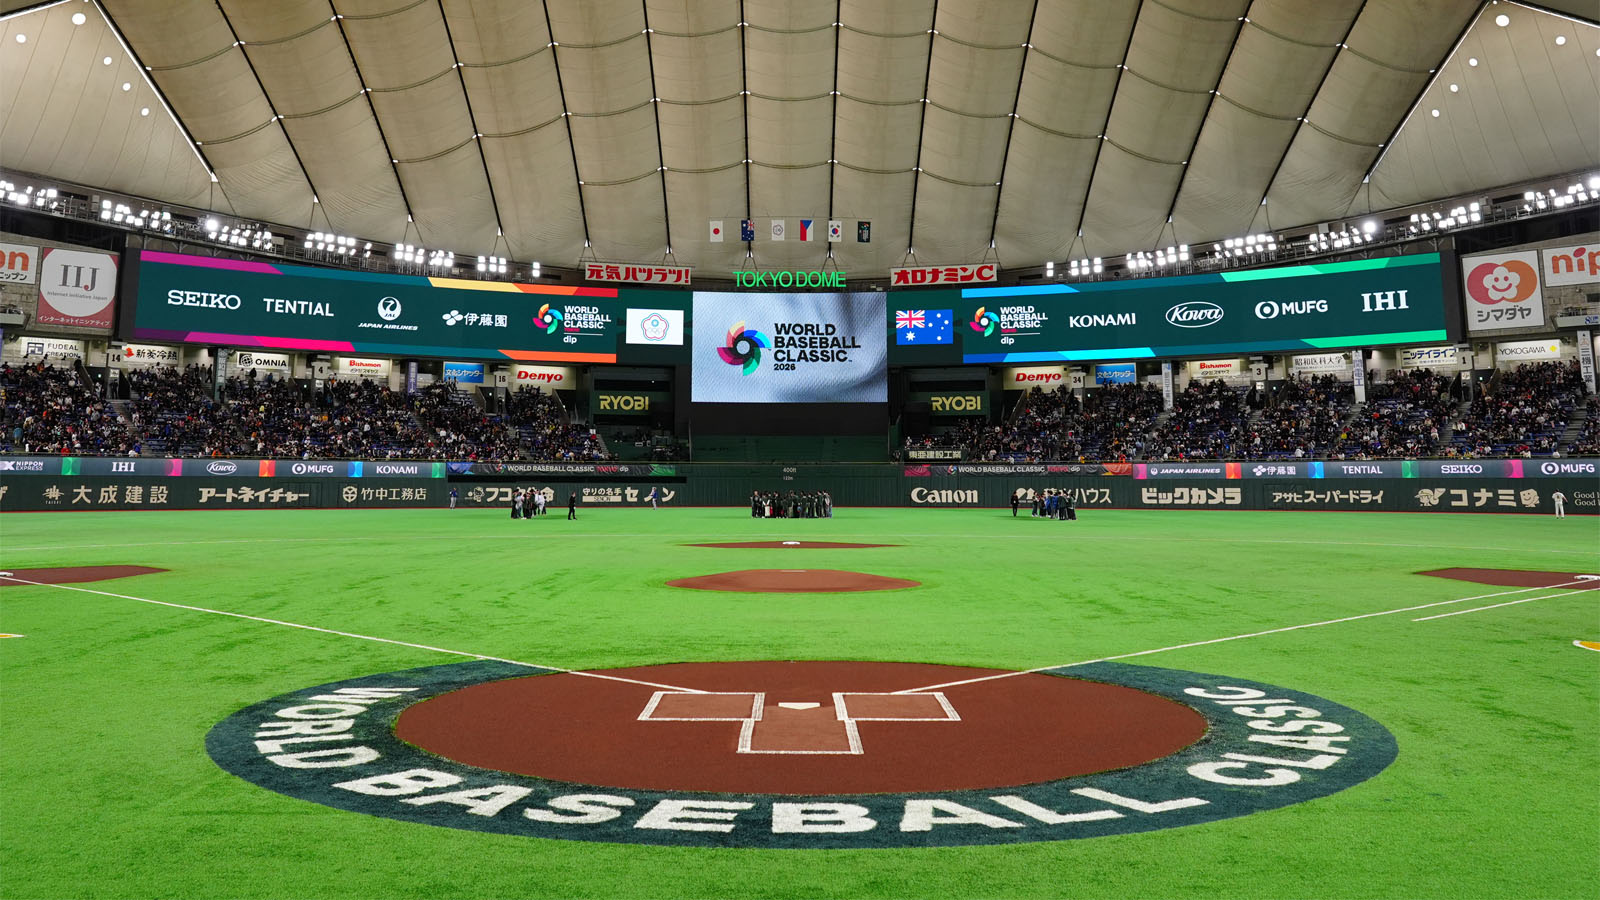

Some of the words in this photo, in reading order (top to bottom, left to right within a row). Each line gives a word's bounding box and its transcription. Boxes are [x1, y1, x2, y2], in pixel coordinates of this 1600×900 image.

[59, 264, 100, 292] IIJ
[587, 264, 691, 284] 元気ハツラツ!
[733, 271, 795, 288] TOKYO
[795, 271, 847, 288] DOME
[894, 265, 994, 284] オロナミンC
[168, 289, 241, 311] SEIKO
[1361, 289, 1409, 313] IHI
[263, 297, 335, 317] TENTIAL
[564, 305, 599, 314] WORLD
[1000, 305, 1035, 315] WORLD
[1281, 299, 1329, 316] MUFG
[564, 312, 612, 323] BASEBALL
[1000, 312, 1049, 322] BASEBALL
[1170, 306, 1222, 322] Kowa
[1477, 305, 1532, 323] シマダヤ
[464, 312, 508, 328] 伊藤園
[563, 320, 604, 330] CLASSIC
[1000, 320, 1041, 330] CLASSIC
[1069, 312, 1137, 328] KONAMI
[358, 322, 383, 330] JAPAN
[384, 323, 419, 332] AIRLINES
[774, 323, 836, 336] WORLD
[563, 335, 578, 345] dip
[774, 336, 861, 349] BASEBALL
[1000, 336, 1015, 346] dip
[47, 343, 79, 352] FUDEAL
[1499, 346, 1547, 359] YOKOGAWA
[111, 352, 121, 363] 14
[136, 349, 178, 361] 新菱冷熱
[774, 350, 848, 363] CLASSIC
[1462, 356, 1467, 364] 1
[255, 357, 288, 368] OMNIA
[349, 359, 382, 371] Bishamon
[774, 363, 796, 372] 2026
[1199, 361, 1232, 370] Bishamon
[318, 365, 324, 373] 4
[1256, 366, 1263, 375] 3
[498, 375, 506, 383] 16
[516, 370, 564, 384] Denyo
[1015, 371, 1062, 384] Denyo
[1072, 375, 1082, 384] 34
[599, 395, 649, 411] RYOBI
[931, 395, 982, 411] RYOBI
[111, 461, 136, 472] IHI
[208, 462, 236, 472] Kowa
[307, 464, 335, 474] MUFG
[376, 464, 419, 475] KONAMI
[508, 464, 532, 472] WORLD
[532, 464, 566, 473] BASEBALL
[566, 465, 595, 473] CLASSIC
[958, 466, 983, 474] WORLD
[983, 465, 1016, 474] BASEBALL
[1016, 465, 1045, 473] CLASSIC
[1070, 464, 1080, 473] dip
[1159, 466, 1185, 475] JAPAN
[1185, 465, 1221, 475] AIRLINES
[1266, 465, 1297, 476] 伊藤園
[1341, 465, 1383, 475] TENTIAL
[1440, 464, 1482, 474] SEIKO
[1560, 463, 1595, 474] MUFG
[72, 485, 169, 504] 大成建設
[198, 485, 310, 503] アートネイチャー
[360, 486, 428, 502] 竹中工務店
[910, 487, 979, 504] Canon
[1141, 487, 1242, 505] ビックカメラ
[1272, 489, 1384, 504] アサヒスーパードライ
[1449, 488, 1517, 507] コナミ
[1573, 491, 1595, 499] Good
[1574, 498, 1596, 506] Good
[253, 686, 420, 769] WORLD
[1183, 684, 1352, 787] CLASSIC
[331, 767, 1211, 835] BASEBALL
